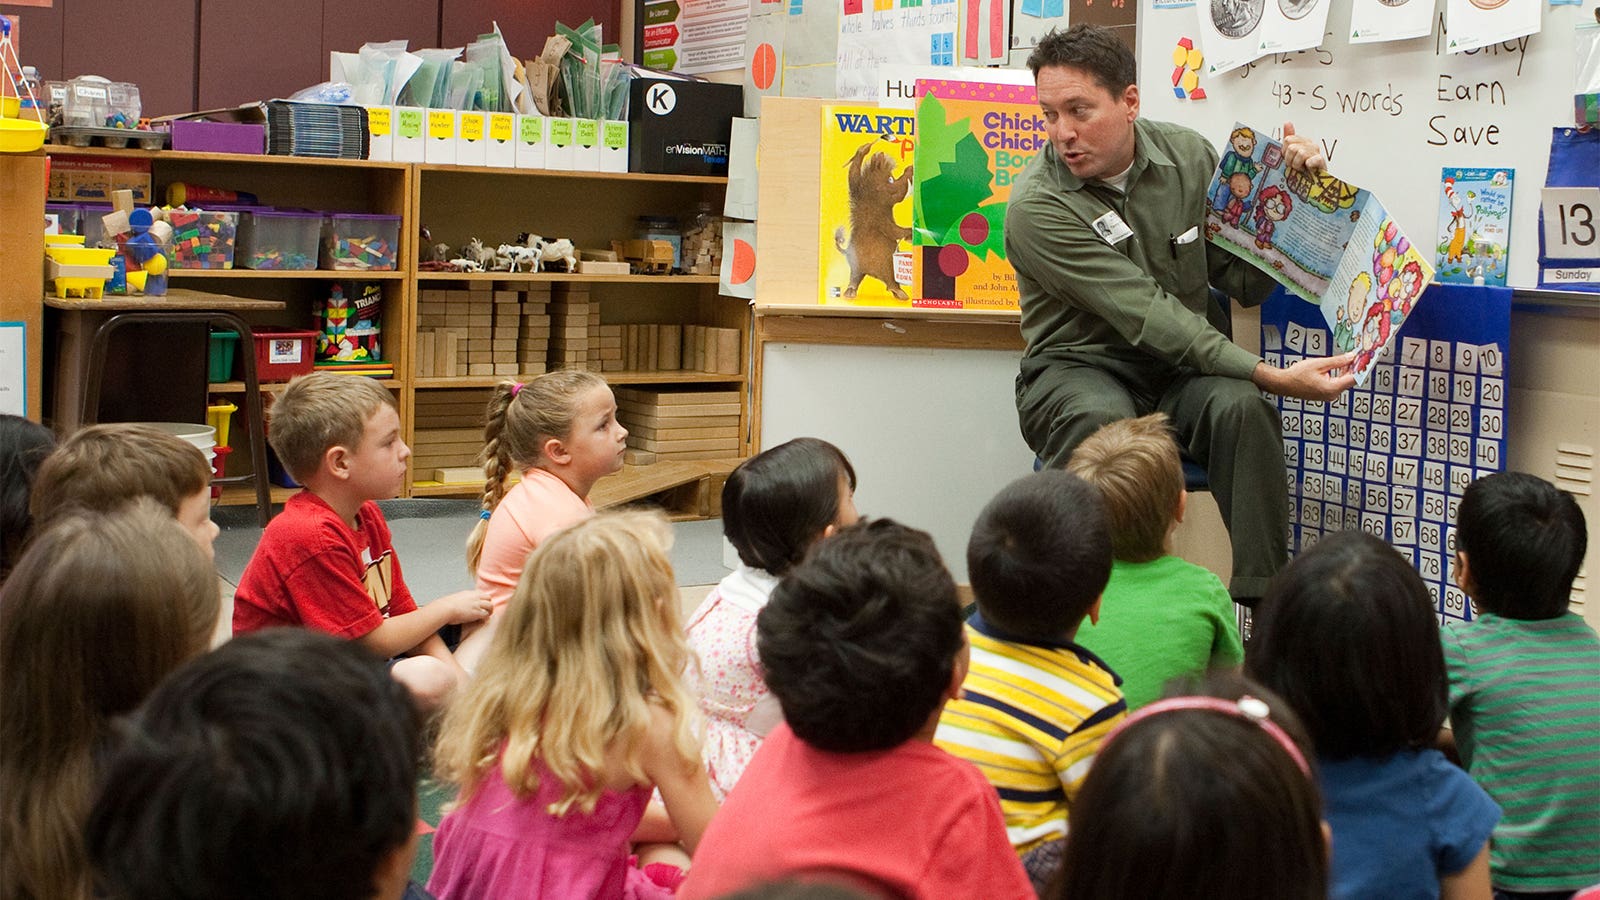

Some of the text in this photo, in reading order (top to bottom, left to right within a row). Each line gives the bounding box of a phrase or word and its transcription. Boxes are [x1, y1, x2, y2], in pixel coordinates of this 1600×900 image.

[841, 15, 863, 33] whole
[872, 11, 895, 32] halves
[900, 9, 926, 27] thirds
[652, 87, 670, 111] K
[1336, 82, 1404, 117] words
[1437, 73, 1506, 106] Earn
[983, 111, 1046, 132] Chick
[1426, 114, 1500, 147] Save
[983, 131, 1046, 151] Chick
[1558, 202, 1597, 246] 13
[973, 282, 988, 290] and
[990, 283, 1008, 292] John
[992, 272, 1001, 281] by
[1555, 269, 1592, 281] Sunday
[918, 299, 963, 307] SCHOLASTIC
[965, 296, 1015, 307] illustrated by
[1289, 328, 1300, 346] 2
[1311, 333, 1321, 350] 3
[1409, 342, 1421, 360] 7
[1434, 345, 1444, 363] 8
[1462, 349, 1473, 367] 9
[1480, 349, 1497, 368] 10
[1377, 369, 1391, 387] 16
[1402, 373, 1421, 391] 17
[1431, 376, 1447, 395] 18
[1456, 380, 1473, 398] 19
[1482, 383, 1502, 402] 20
[1331, 393, 1348, 410] 24
[1354, 396, 1369, 414] 25
[1373, 398, 1390, 417] 26
[1397, 402, 1419, 421] 27
[1428, 406, 1447, 425] 28
[1451, 409, 1470, 428] 29
[1481, 414, 1501, 433] 30
[1282, 415, 1497, 463] 32 33 34 35 36 37 38 39 40
[1305, 447, 1323, 465] 43
[1328, 450, 1345, 469] 44
[1349, 453, 1363, 472] 45
[1367, 458, 1386, 478] 46
[1394, 461, 1416, 480] 47
[1424, 465, 1443, 486] 48
[1451, 470, 1471, 489] 49
[1287, 473, 1457, 519] 2 53 54 55 56 57 58 5
[1288, 501, 1457, 551] 2 63 64 65 66 67 68 6
[1421, 555, 1440, 575] 78
[1429, 587, 1438, 605] 8
[1445, 590, 1464, 611] 89
